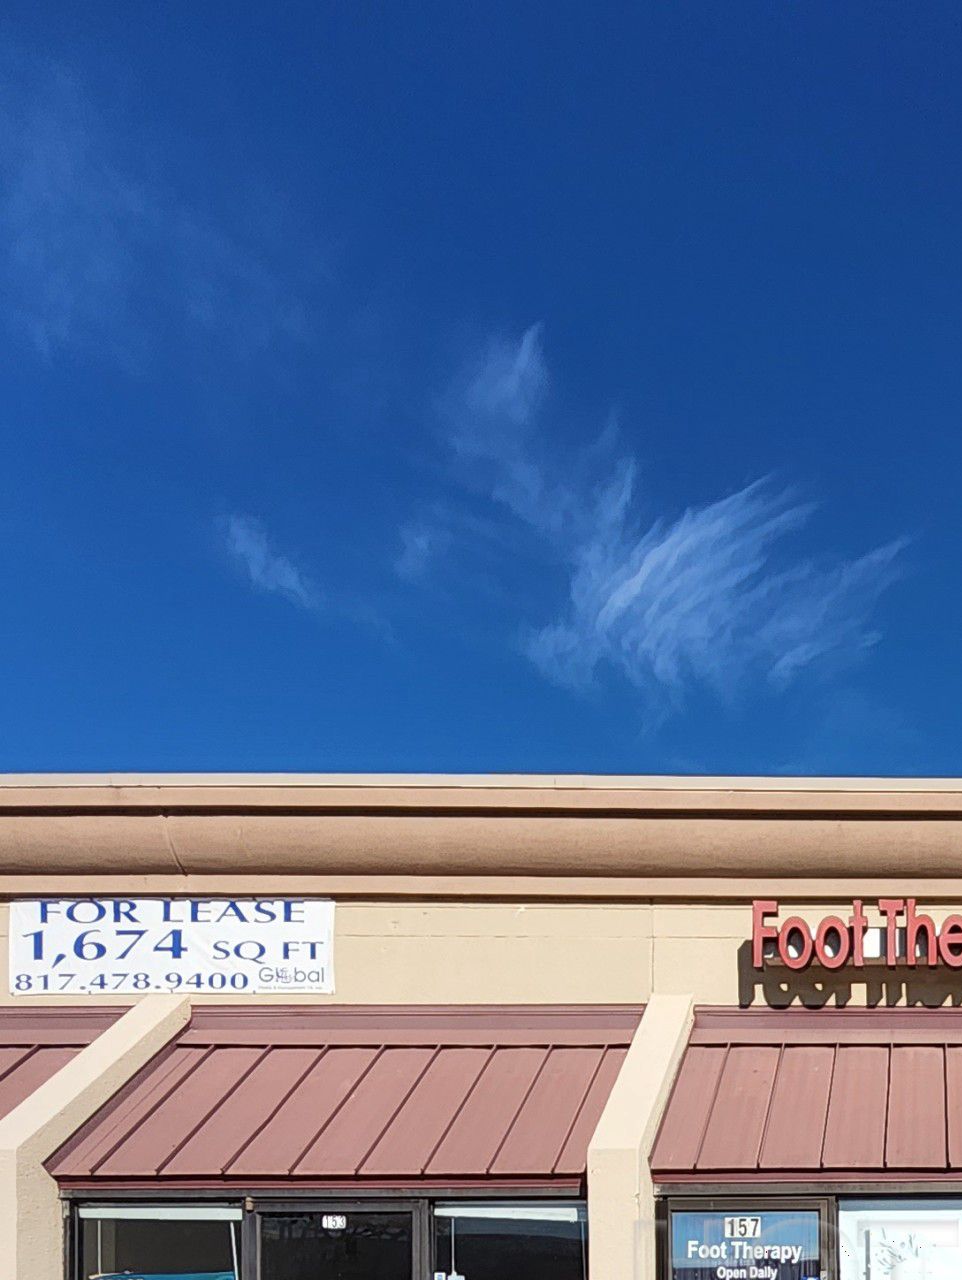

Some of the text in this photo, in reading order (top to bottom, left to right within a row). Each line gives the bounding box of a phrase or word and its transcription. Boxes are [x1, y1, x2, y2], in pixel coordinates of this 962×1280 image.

[39, 899, 306, 924] FOR LEASE
[752, 899, 868, 969] Foot
[22, 928, 325, 968] 1,674 SQ FT
[14, 972, 249, 991] 817.478.9400
[727, 1218, 760, 1237] 157
[687, 1240, 803, 1263] Foot Therapy
[716, 1266, 778, 1280] Open Daily
